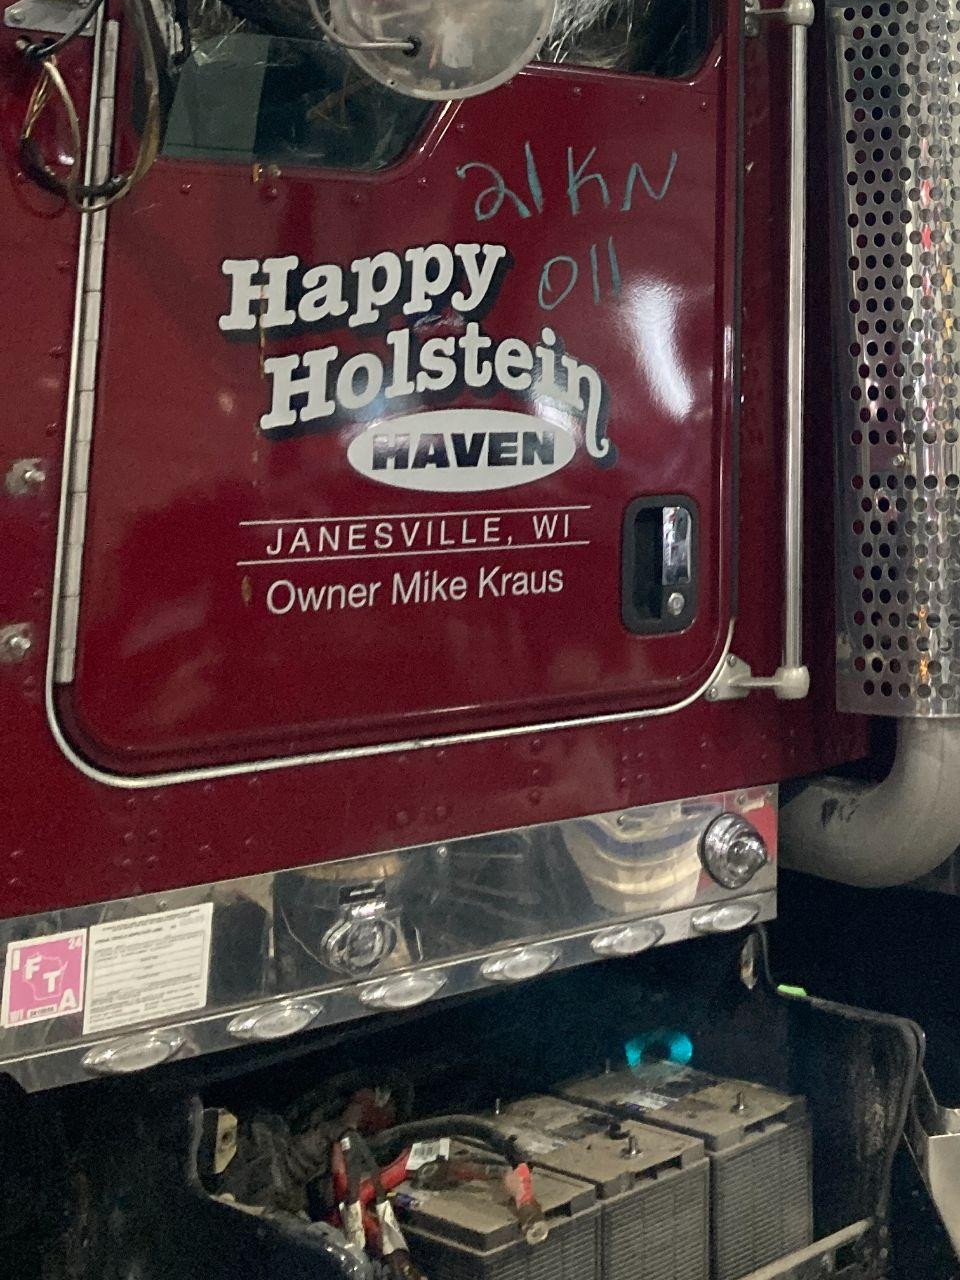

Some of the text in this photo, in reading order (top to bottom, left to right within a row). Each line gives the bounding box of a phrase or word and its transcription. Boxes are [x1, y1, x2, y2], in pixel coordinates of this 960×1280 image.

[218, 242, 507, 331] Happy
[259, 321, 610, 459] Holstein
[371, 430, 556, 471] HAVEN
[265, 513, 570, 556] JANESVILLE, WI
[265, 566, 565, 615] Owner Mike Kraus
